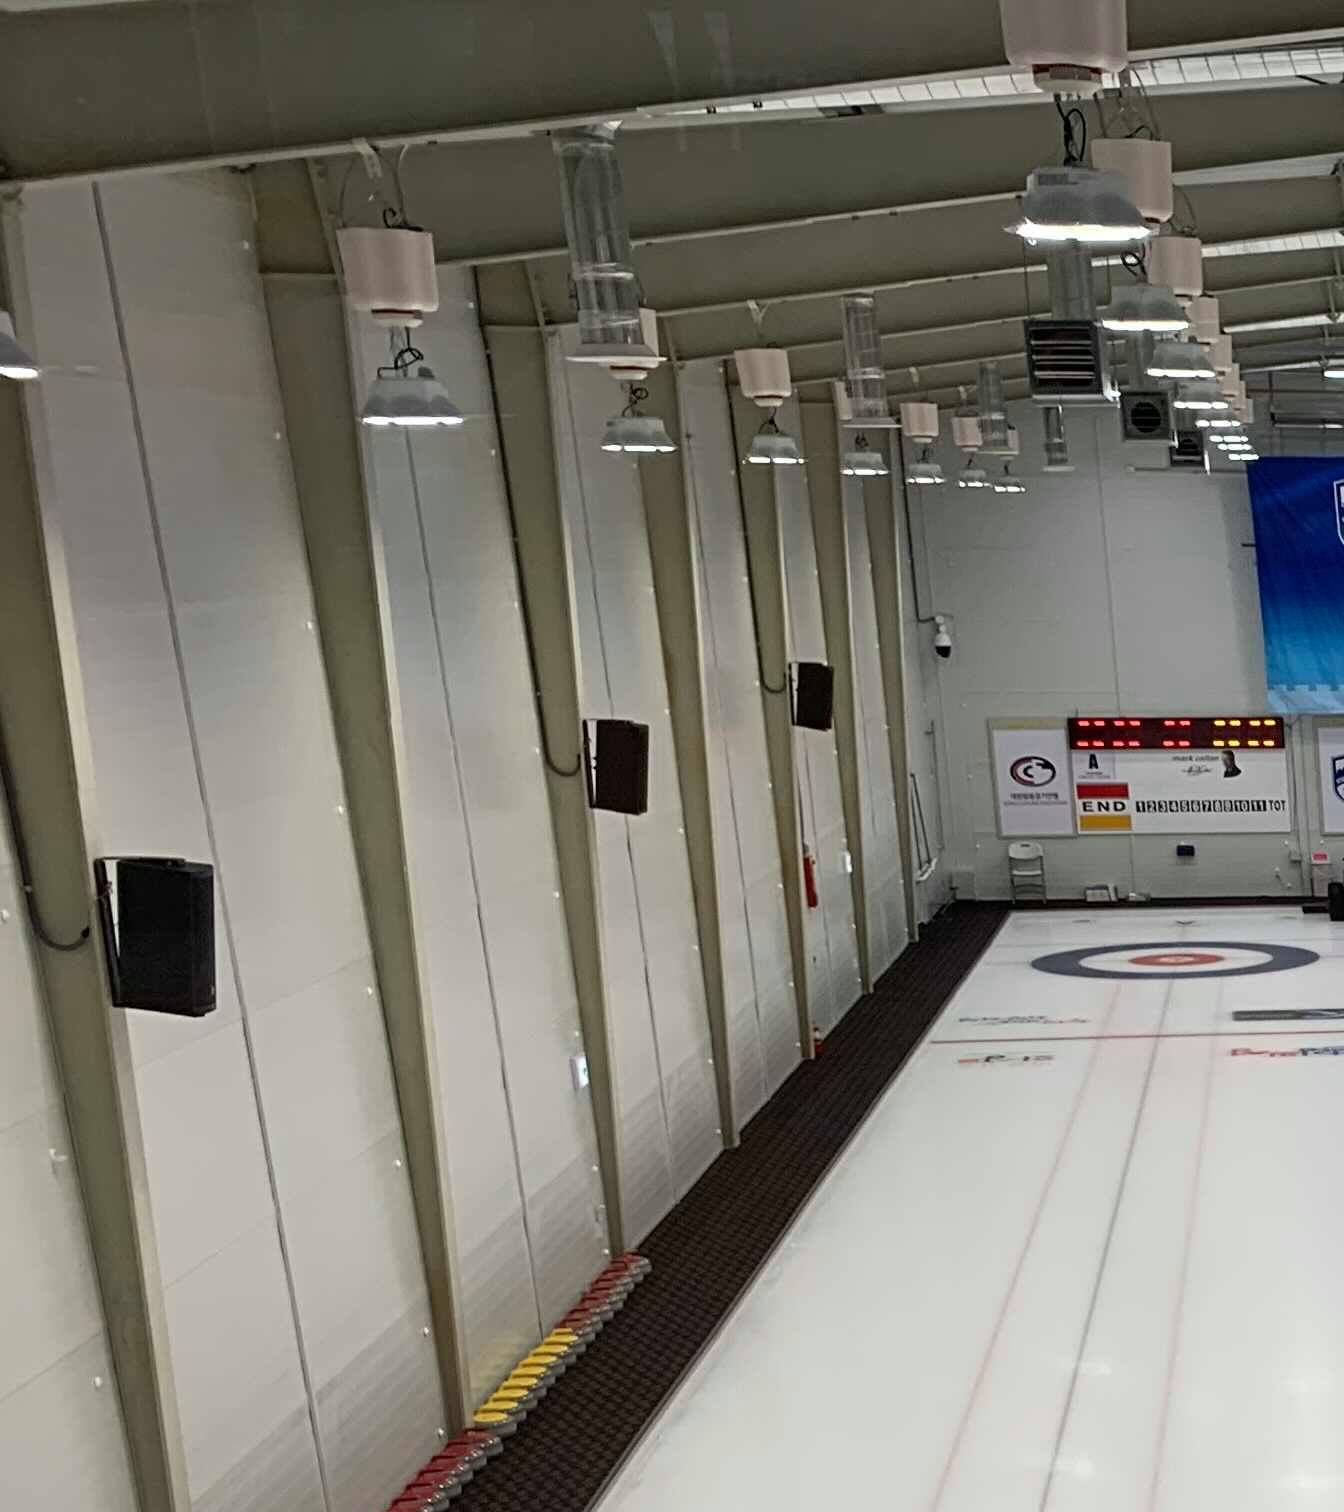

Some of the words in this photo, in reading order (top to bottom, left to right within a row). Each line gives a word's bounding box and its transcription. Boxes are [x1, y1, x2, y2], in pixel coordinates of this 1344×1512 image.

[1088, 753, 1099, 769] A
[1082, 800, 1127, 812] END
[1252, 801, 1265, 810] 11
[1269, 800, 1285, 811] TOT
